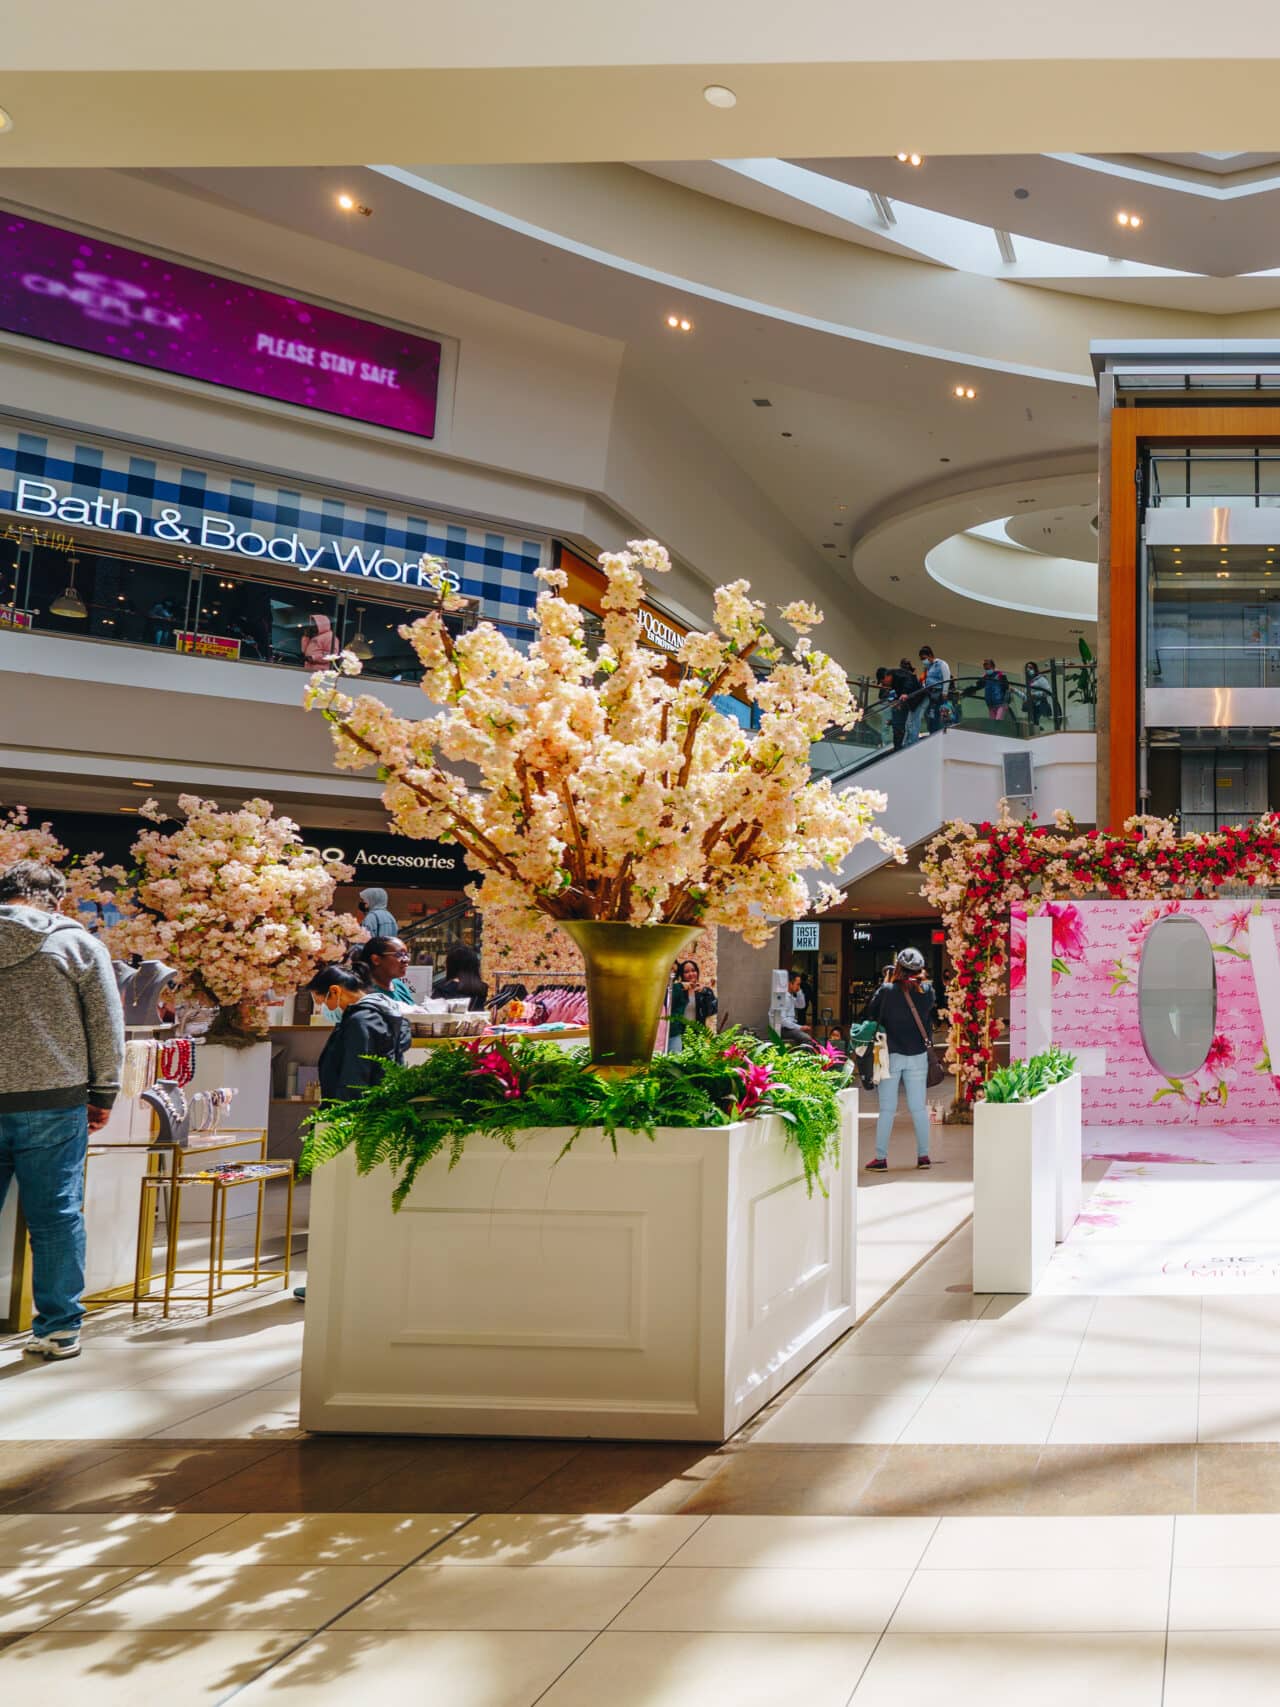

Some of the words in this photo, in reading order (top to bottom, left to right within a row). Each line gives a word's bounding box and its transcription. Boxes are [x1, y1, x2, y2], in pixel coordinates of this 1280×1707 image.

[257, 332, 315, 367] PLEASE
[319, 351, 356, 376] STAY
[360, 362, 400, 389] SAFE.
[16, 478, 142, 535] Bath
[153, 508, 192, 544] &
[201, 515, 325, 571] Body
[331, 541, 461, 593] Works
[354, 849, 456, 870] Accessories
[796, 926, 817, 937] TASTE
[796, 937, 816, 948] MRKT
